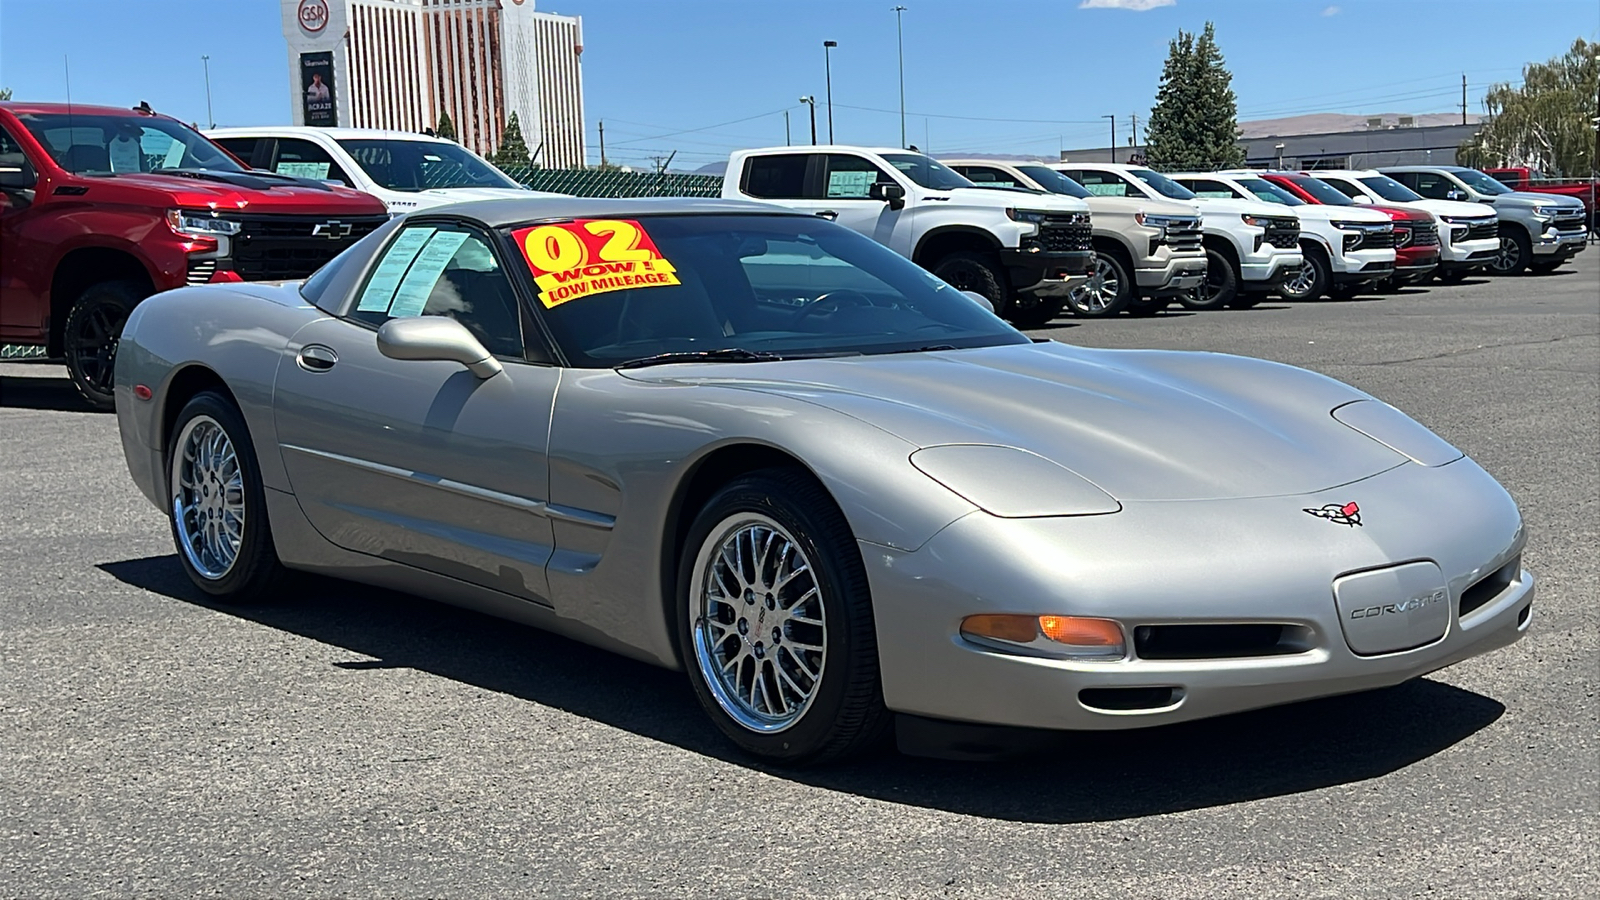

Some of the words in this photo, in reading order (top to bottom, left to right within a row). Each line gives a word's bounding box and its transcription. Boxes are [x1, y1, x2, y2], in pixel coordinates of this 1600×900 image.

[302, 5, 324, 21] GSR
[525, 220, 656, 273] 02
[549, 283, 588, 303] LOW
[592, 272, 670, 292] MILEAGE
